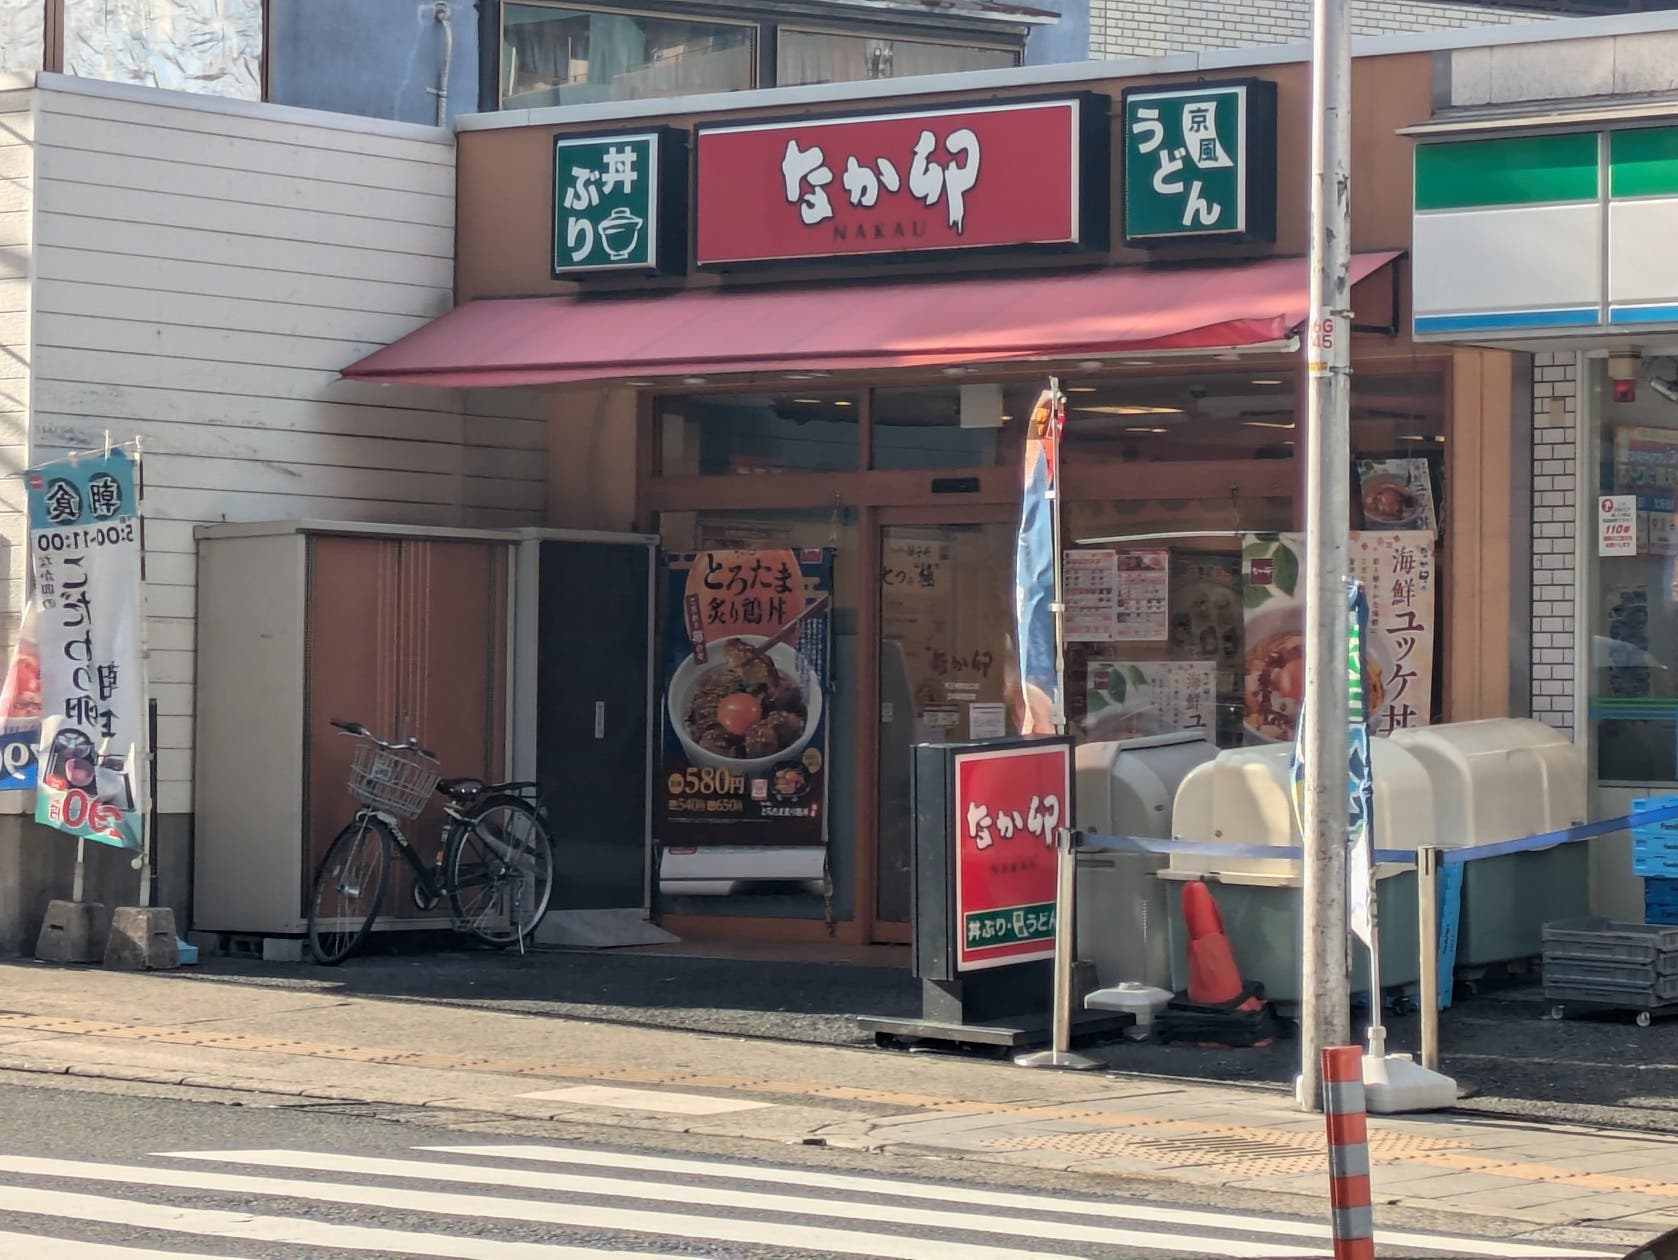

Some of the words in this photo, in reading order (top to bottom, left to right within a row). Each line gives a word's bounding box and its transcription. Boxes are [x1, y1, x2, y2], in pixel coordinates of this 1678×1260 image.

[1188, 107, 1219, 163] 京風
[782, 128, 980, 235] なか卯
[1132, 108, 1222, 227] うどん
[563, 146, 638, 262] 丼ぶり
[832, 220, 928, 241] NAKAU
[704, 552, 792, 597] とろたま
[1379, 546, 1425, 736] 海鮮ユッケ丼
[685, 766, 745, 795] 580円
[967, 794, 1060, 850] なか卯
